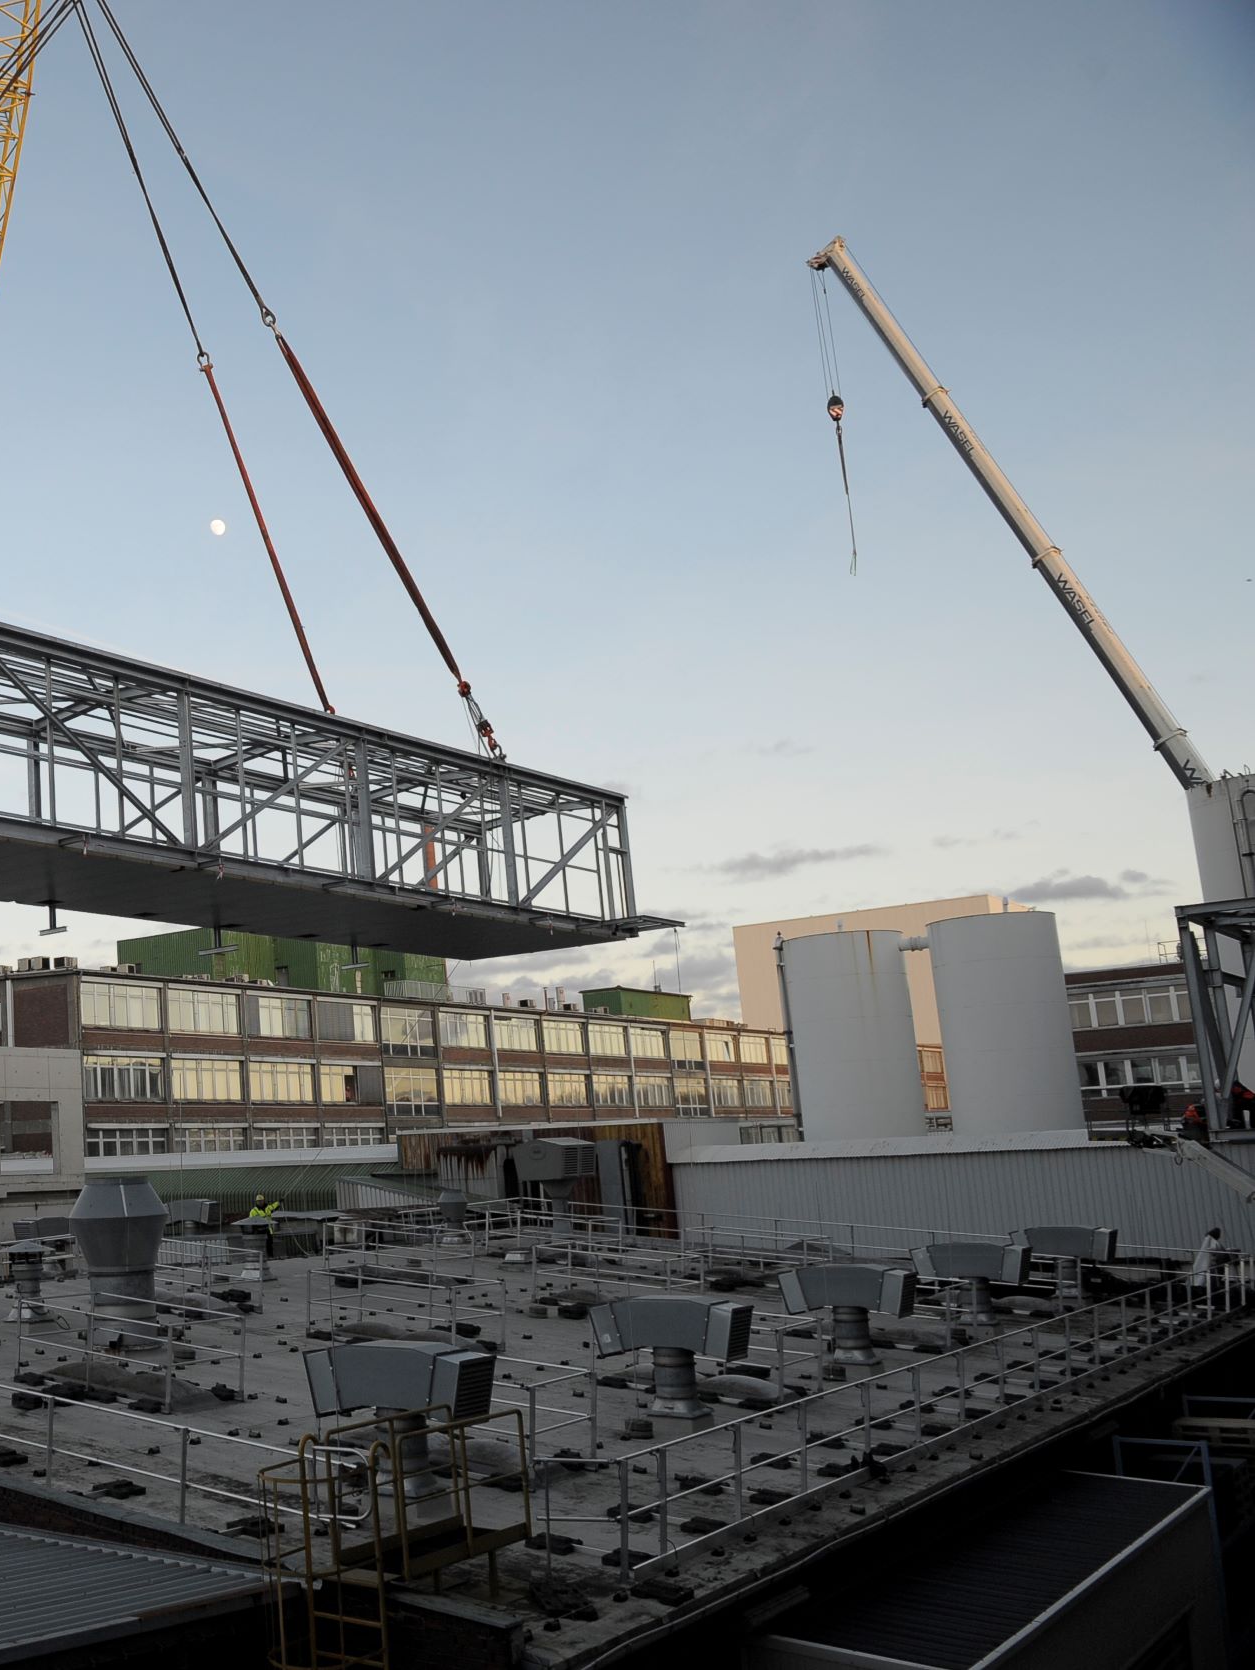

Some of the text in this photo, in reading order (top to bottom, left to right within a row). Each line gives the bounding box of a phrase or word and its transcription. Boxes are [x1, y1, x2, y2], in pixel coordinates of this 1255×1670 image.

[842, 265, 867, 302] WASEL
[942, 409, 974, 457] WASEL
[1057, 572, 1095, 632] WASEL
